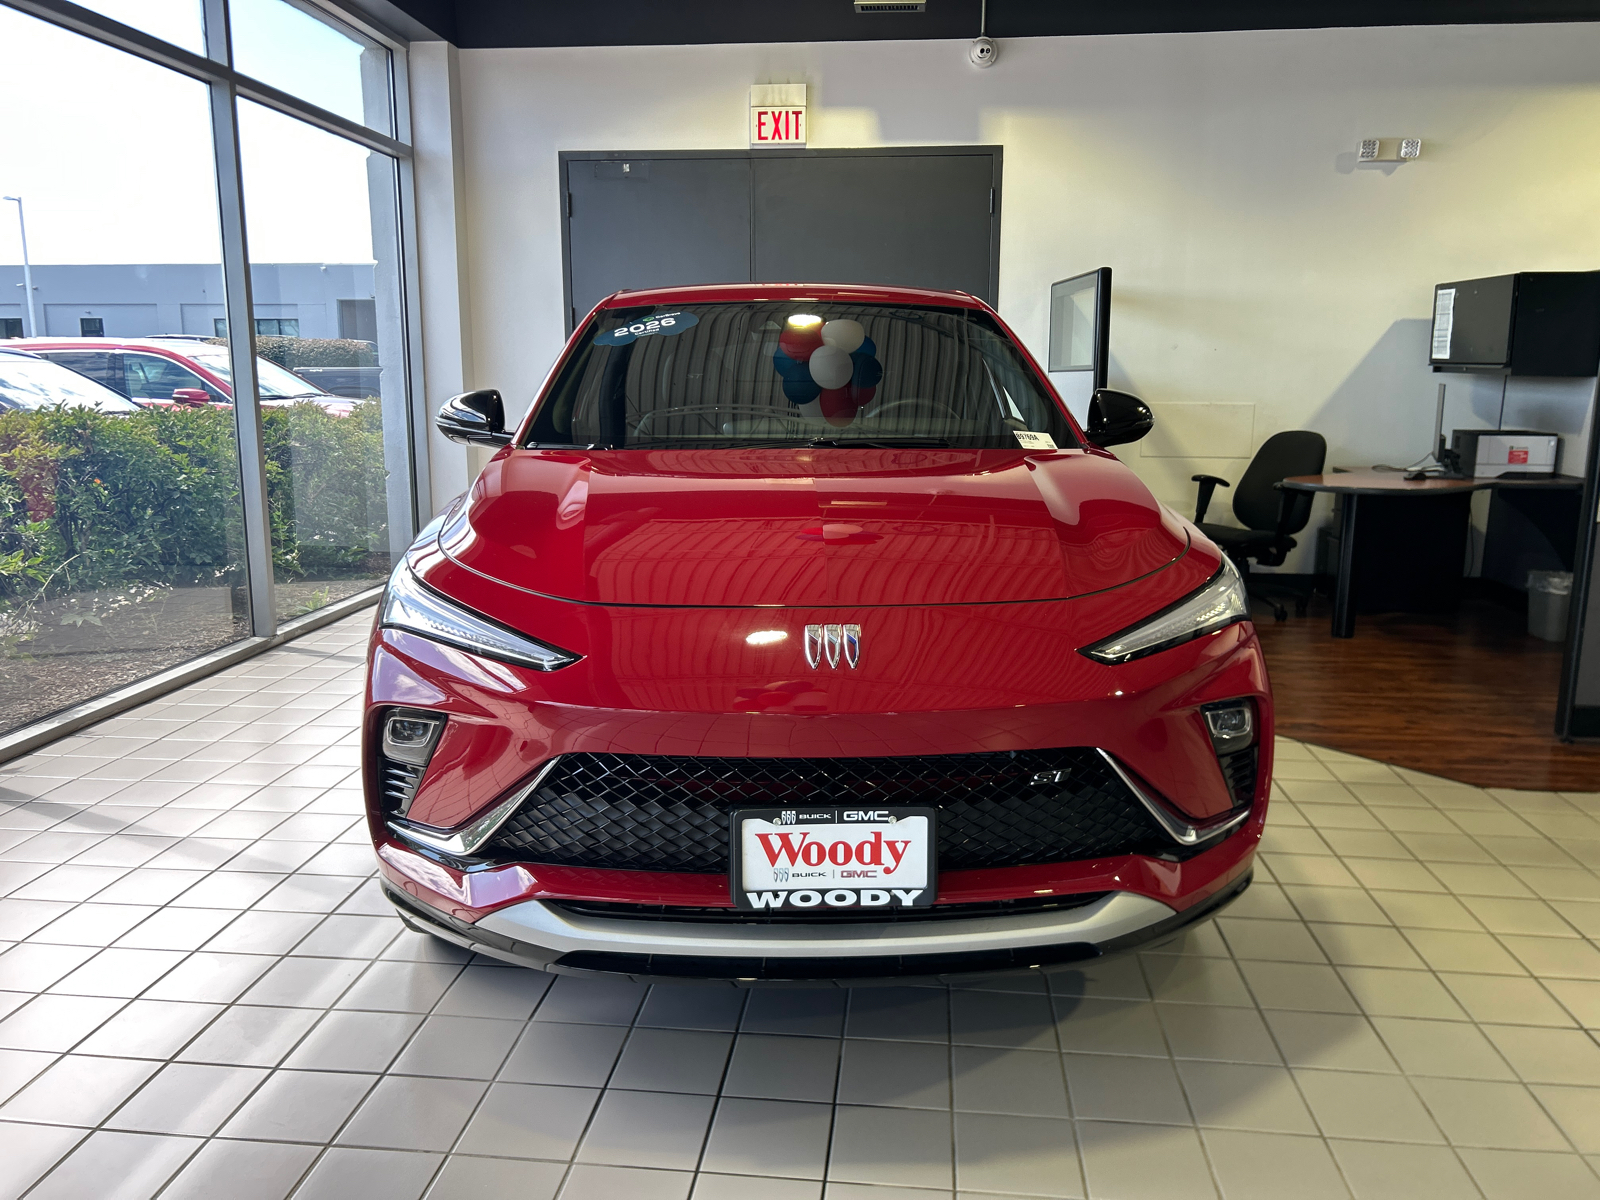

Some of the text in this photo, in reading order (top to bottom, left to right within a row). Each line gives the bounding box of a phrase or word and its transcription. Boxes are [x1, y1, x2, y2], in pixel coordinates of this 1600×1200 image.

[758, 111, 802, 140] EXIT
[614, 317, 676, 337] 2026
[1027, 768, 1072, 786] ST
[843, 810, 889, 821] GMC
[754, 831, 912, 875] Woody
[840, 869, 878, 878] GMC
[746, 889, 924, 909] WOODY
